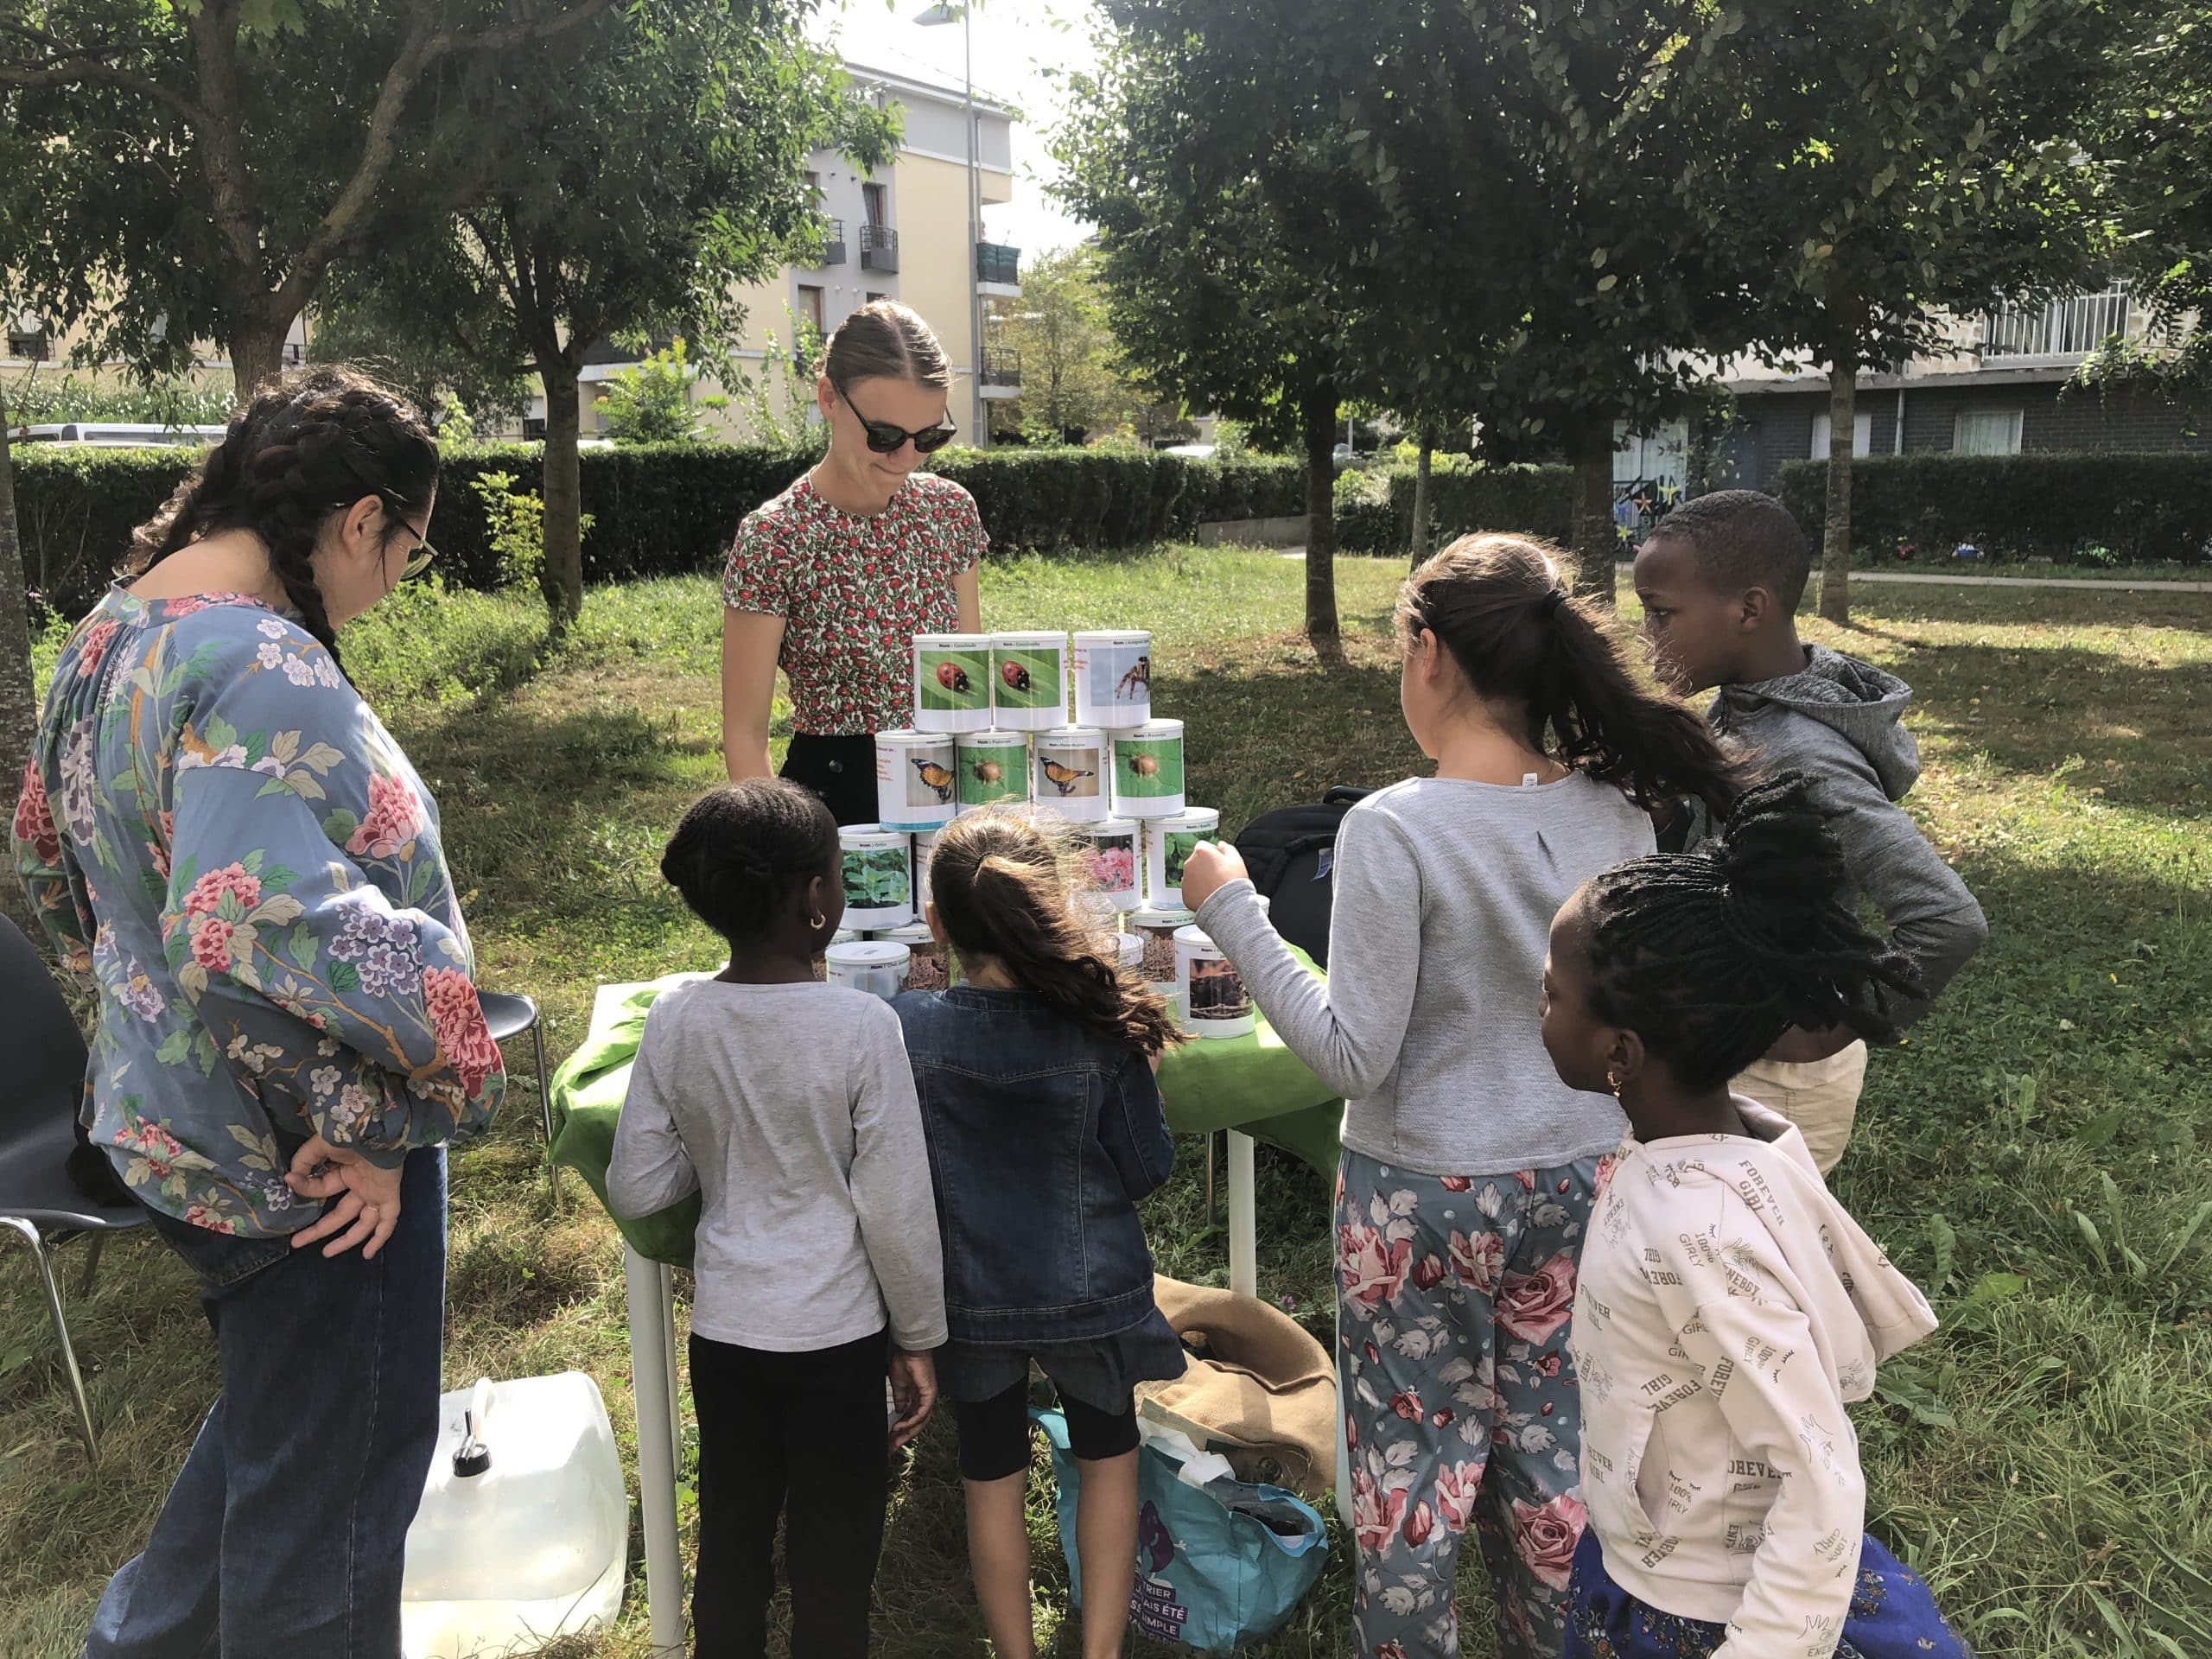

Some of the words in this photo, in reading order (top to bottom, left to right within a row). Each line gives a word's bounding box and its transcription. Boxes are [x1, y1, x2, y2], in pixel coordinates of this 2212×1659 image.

[1738, 1160, 1785, 1226] FOREVER
[1739, 1180, 1765, 1211] GIRL
[1679, 1233, 1705, 1268] GIRLY
[1694, 1233, 1714, 1263] 100%
[1727, 1268, 1761, 1297] NERGY
[1682, 1323, 1709, 1335] GIRL
[1641, 1374, 1673, 1396] GIRL
[1669, 1497, 1689, 1515] IRLY
[1162, 1603, 1185, 1620] ÉTÉ
